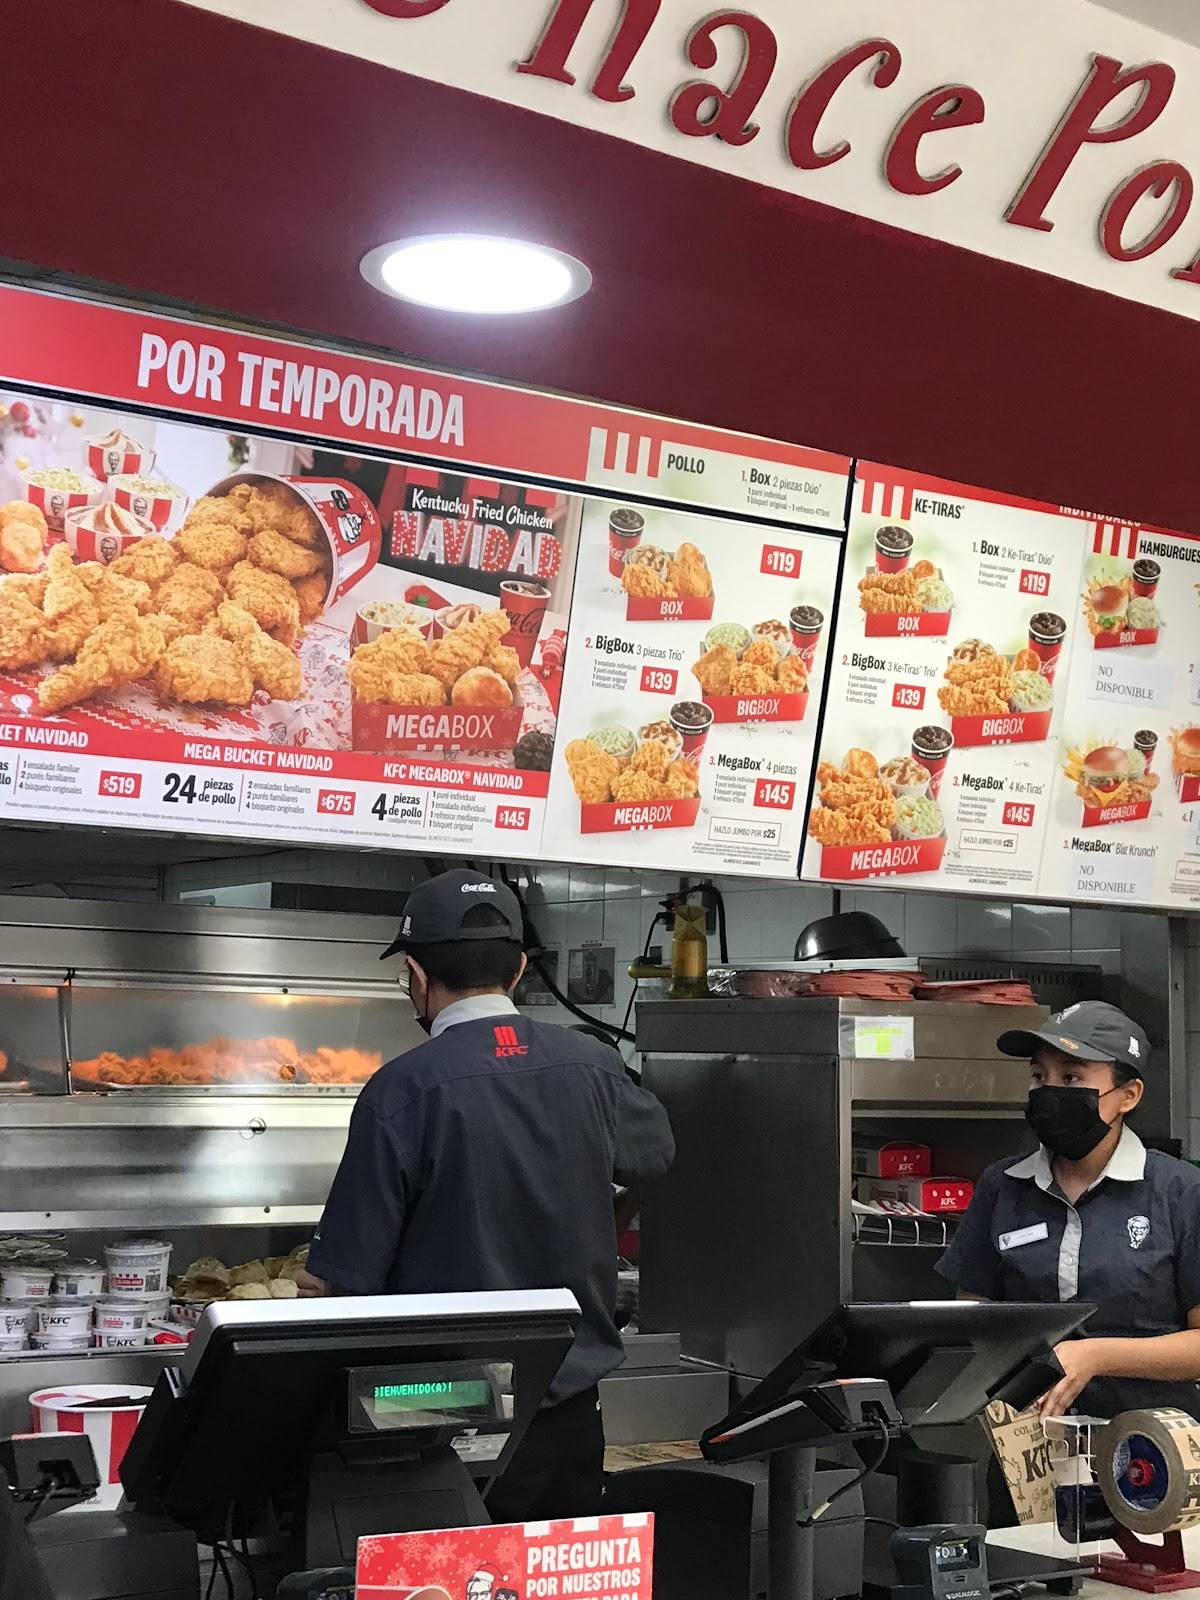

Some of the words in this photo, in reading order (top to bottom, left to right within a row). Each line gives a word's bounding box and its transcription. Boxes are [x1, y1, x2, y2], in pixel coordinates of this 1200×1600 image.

[1004, 52, 1200, 285] Po
[137, 332, 224, 402] POR
[238, 351, 465, 447] TEMPORADA
[667, 453, 705, 474] POLLO
[741, 470, 748, 482] 1.
[750, 468, 771, 486] Box
[773, 476, 779, 487] 2
[779, 478, 802, 492] piezas
[411, 488, 469, 520] Kentucky
[472, 499, 504, 521] Fried
[506, 505, 553, 529] Chicken
[390, 510, 562, 579] NAVIDAD
[972, 542, 978, 553] 1.
[980, 540, 999, 556] Box
[1001, 547, 1006, 558] 2
[767, 550, 795, 572] $119
[1023, 574, 1047, 593] $119
[661, 601, 684, 614] BOX
[897, 616, 920, 631] BOX
[1119, 631, 1136, 643] BOX
[585, 637, 593, 649] 2.
[596, 635, 635, 654] BigBox
[636, 644, 642, 655] 3
[642, 646, 666, 658] piezas
[842, 655, 849, 666] 2.
[851, 653, 886, 671] BigBox
[887, 661, 892, 672] 3
[1098, 665, 1113, 678] NO
[645, 671, 672, 691] $139
[896, 688, 921, 706] $139
[1096, 681, 1154, 700] DISPONIBLE
[737, 699, 780, 716] BIGBOX
[385, 714, 495, 741] MEGABOX
[982, 718, 1025, 737] BIGBOX
[25, 726, 88, 748] NAVIDAD
[184, 742, 220, 761] MEGA
[223, 746, 274, 767] BUCKET
[277, 754, 334, 772] NAVIDAD
[709, 755, 715, 765] 3.
[766, 761, 771, 771] 4
[773, 763, 797, 775] piezas
[21, 770, 26, 779] 2
[384, 762, 406, 778] KFC
[473, 772, 524, 790] NAVIDAD
[103, 776, 135, 795] $519
[162, 772, 197, 804] 24
[203, 778, 235, 792] piezas
[248, 781, 253, 789] 2
[284, 784, 311, 794] familiares
[953, 776, 959, 786] 3.
[1009, 782, 1014, 791] 4
[198, 789, 210, 802] de
[212, 792, 236, 805] pollo
[252, 793, 268, 802] purés
[270, 794, 298, 804] familiares
[394, 793, 420, 805] piezas
[450, 792, 476, 802] individual
[760, 784, 789, 804] $145
[277, 804, 304, 814] originales
[321, 794, 352, 812] $675
[371, 793, 387, 820] 4
[389, 805, 399, 816] de
[401, 807, 422, 818] pollo
[435, 802, 459, 810] ensalada
[460, 803, 486, 812] individual
[434, 811, 456, 820] refresco
[457, 814, 479, 822] mediano
[499, 810, 525, 826] $145
[614, 805, 673, 825] MEGABOX
[1007, 806, 1030, 823] $145
[1100, 804, 1138, 821] MEGABOX
[454, 822, 473, 831] original
[714, 826, 731, 835] HAZLO
[732, 827, 750, 836] JUMBO
[751, 828, 762, 837] POR
[763, 829, 776, 839] $25
[1003, 839, 1013, 848] $25
[851, 845, 922, 871] MEGABOX
[1079, 864, 1094, 876] NO
[461, 883, 496, 893] Coca-Cola
[1077, 880, 1136, 894] DISPONIBLE
[495, 1045, 528, 1057] KFC
[898, 1163, 914, 1171] KFC
[940, 1197, 956, 1206] KFC
[50, 1316, 71, 1325] KFC
[117, 1338, 137, 1347] KFC
[1022, 1439, 1055, 1483] KFC
[527, 1537, 641, 1574] PREGUNTA
[526, 1577, 558, 1598] POR
[562, 1568, 641, 1595] NUESTROS
